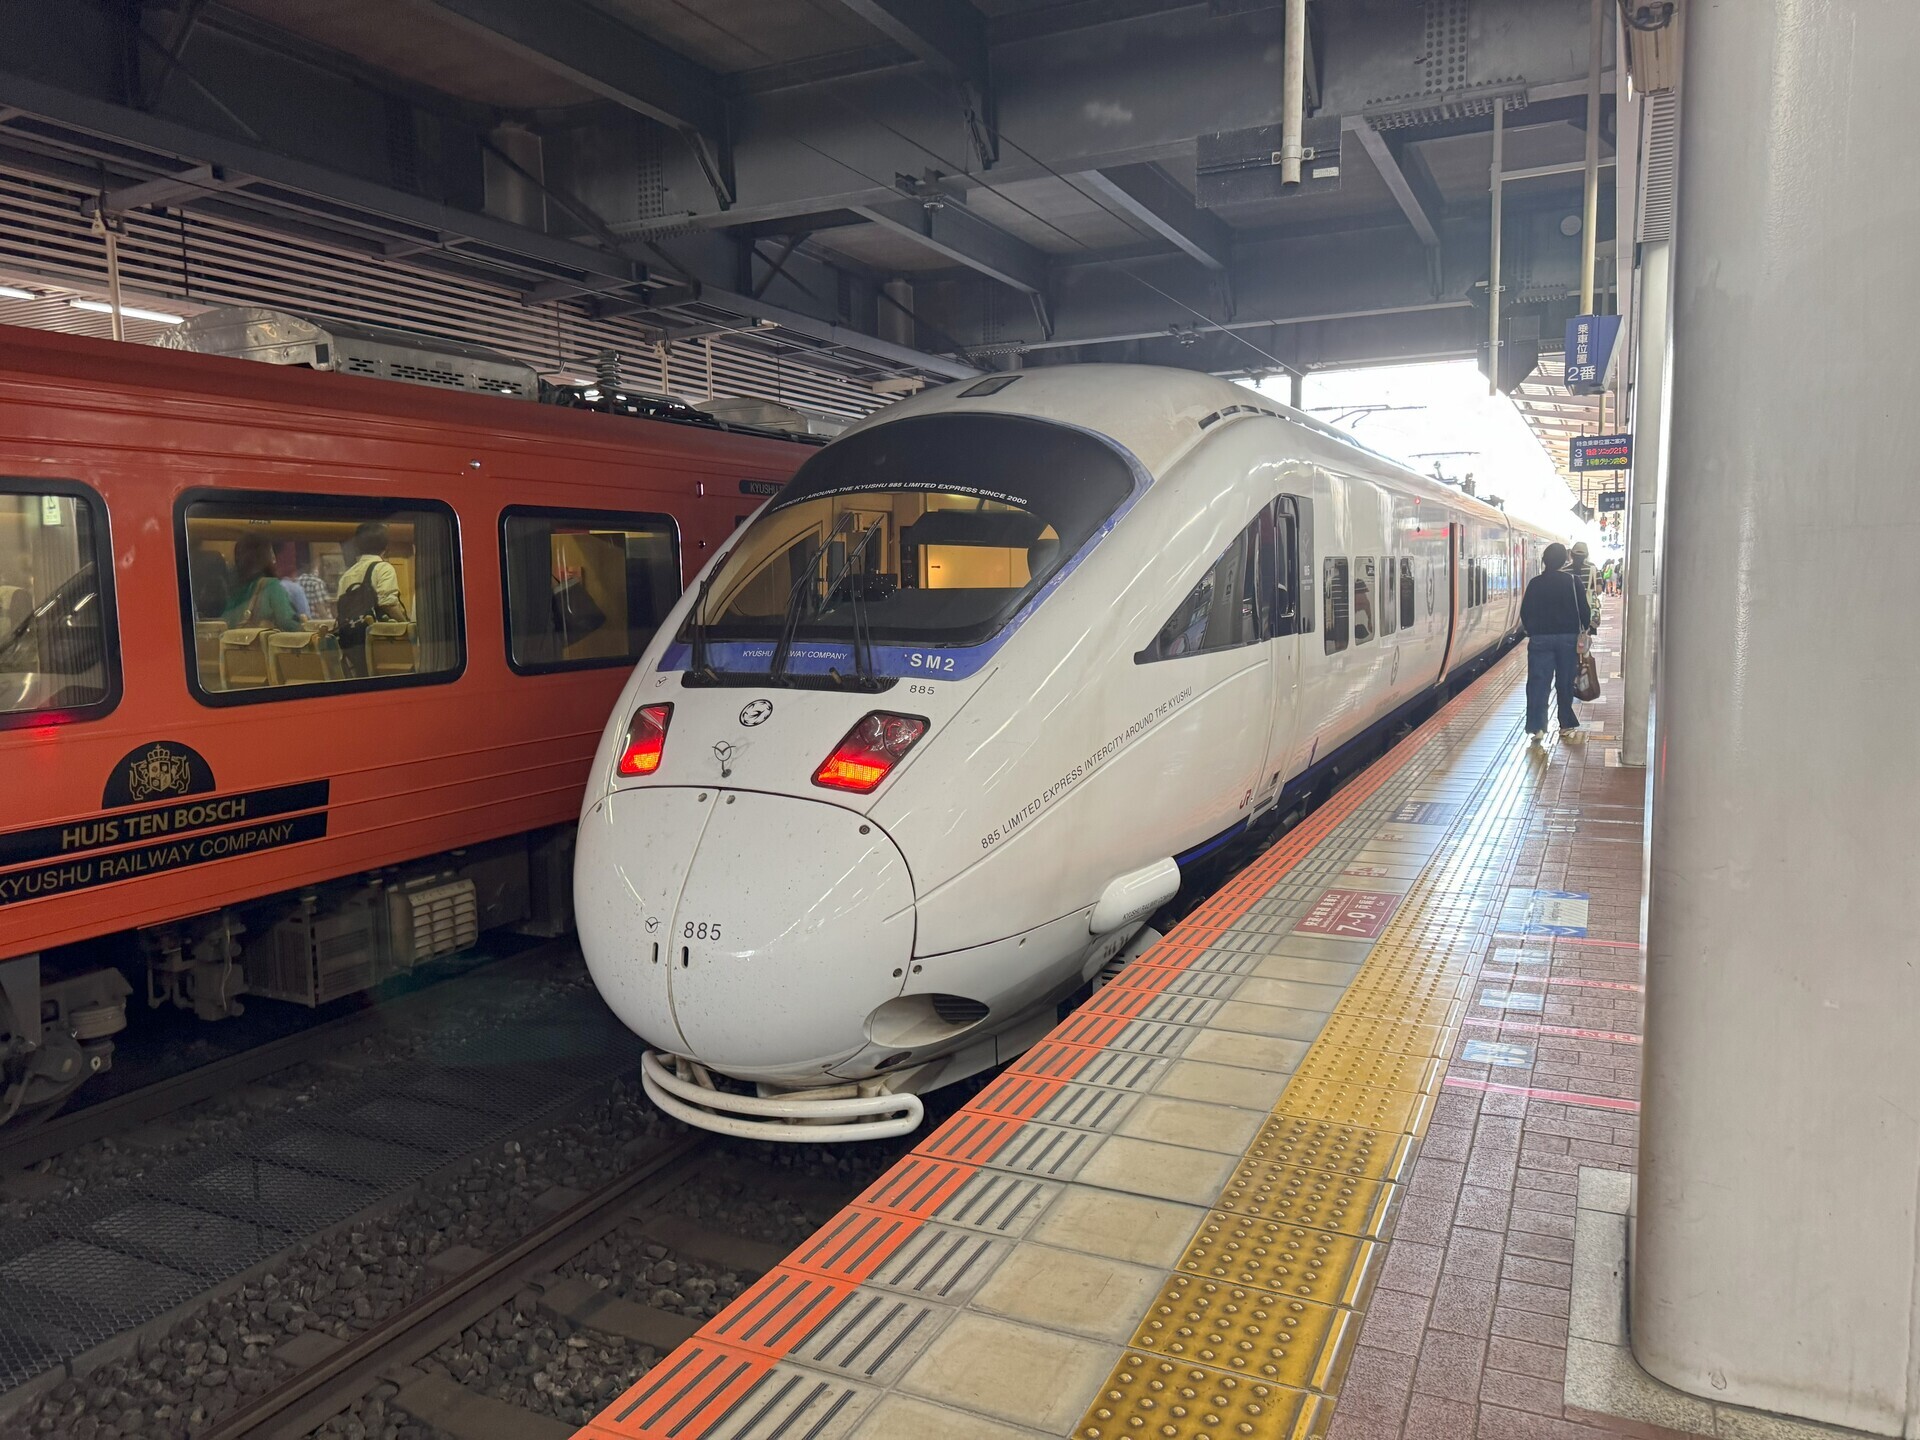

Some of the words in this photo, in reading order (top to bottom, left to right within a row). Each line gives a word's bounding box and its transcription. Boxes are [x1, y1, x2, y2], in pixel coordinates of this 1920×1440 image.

[1576, 323, 1589, 365] 乗車位置
[1567, 365, 1596, 381] 2番
[805, 488, 838, 500] AROUND
[854, 482, 888, 490] KYUSHU
[938, 483, 978, 494] EXPRESS
[979, 489, 1006, 499] SINCE
[1006, 495, 1028, 505] 2000
[808, 651, 848, 660] COMPANY
[910, 653, 955, 672] SM2
[909, 684, 935, 695] 885
[981, 829, 1001, 849] 885
[1002, 798, 1041, 834] LIMITED
[1042, 765, 1083, 803] EXPRESS
[1084, 733, 1124, 771] INTERCITY
[1124, 712, 1154, 741] AROUND
[1154, 703, 1168, 718] THE
[1168, 686, 1193, 709] KYUSHU
[62, 821, 119, 849] HUIS
[124, 812, 169, 837] TEN
[175, 799, 246, 828] BOSCH
[100, 843, 195, 878] RAILWAY
[200, 823, 294, 857] COMPANY
[683, 921, 722, 941] 885
